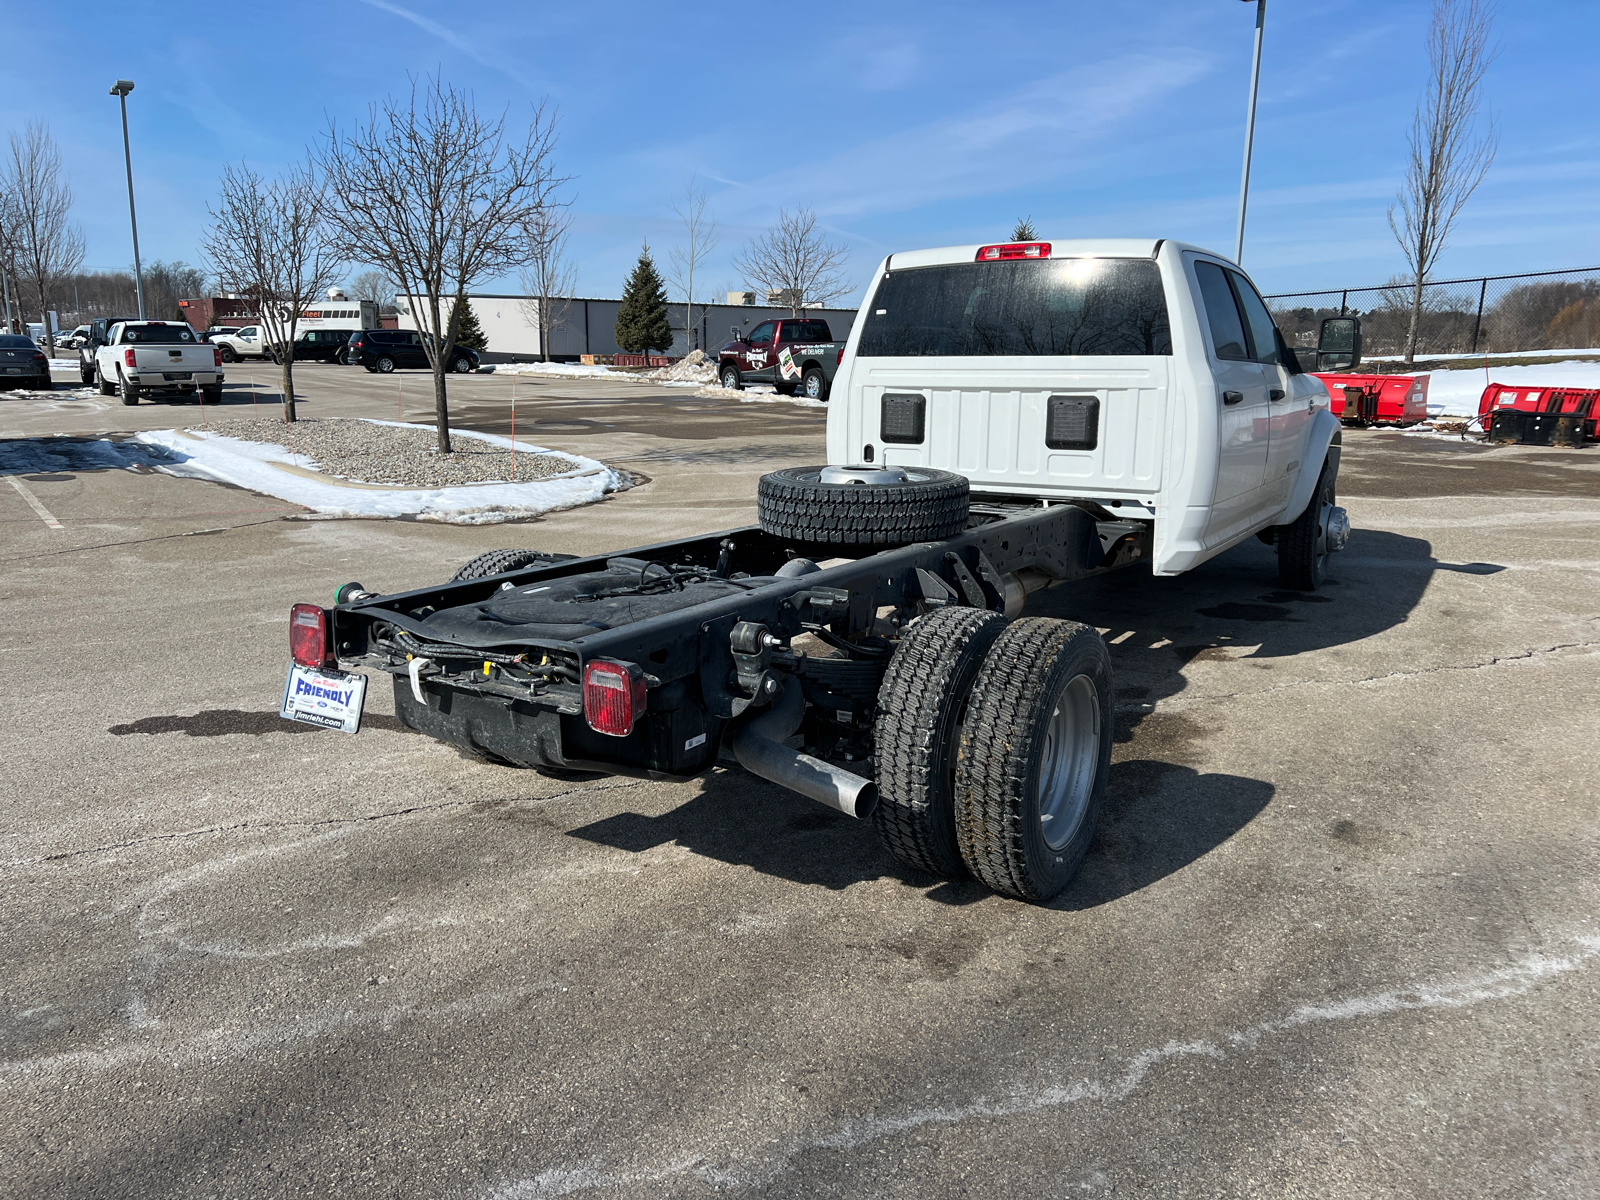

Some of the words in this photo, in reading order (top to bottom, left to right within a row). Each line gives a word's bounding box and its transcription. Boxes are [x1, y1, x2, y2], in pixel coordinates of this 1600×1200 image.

[302, 310, 321, 318] Fleet
[295, 677, 354, 708] FRIENDLY
[295, 712, 341, 727] jimriehl.com
